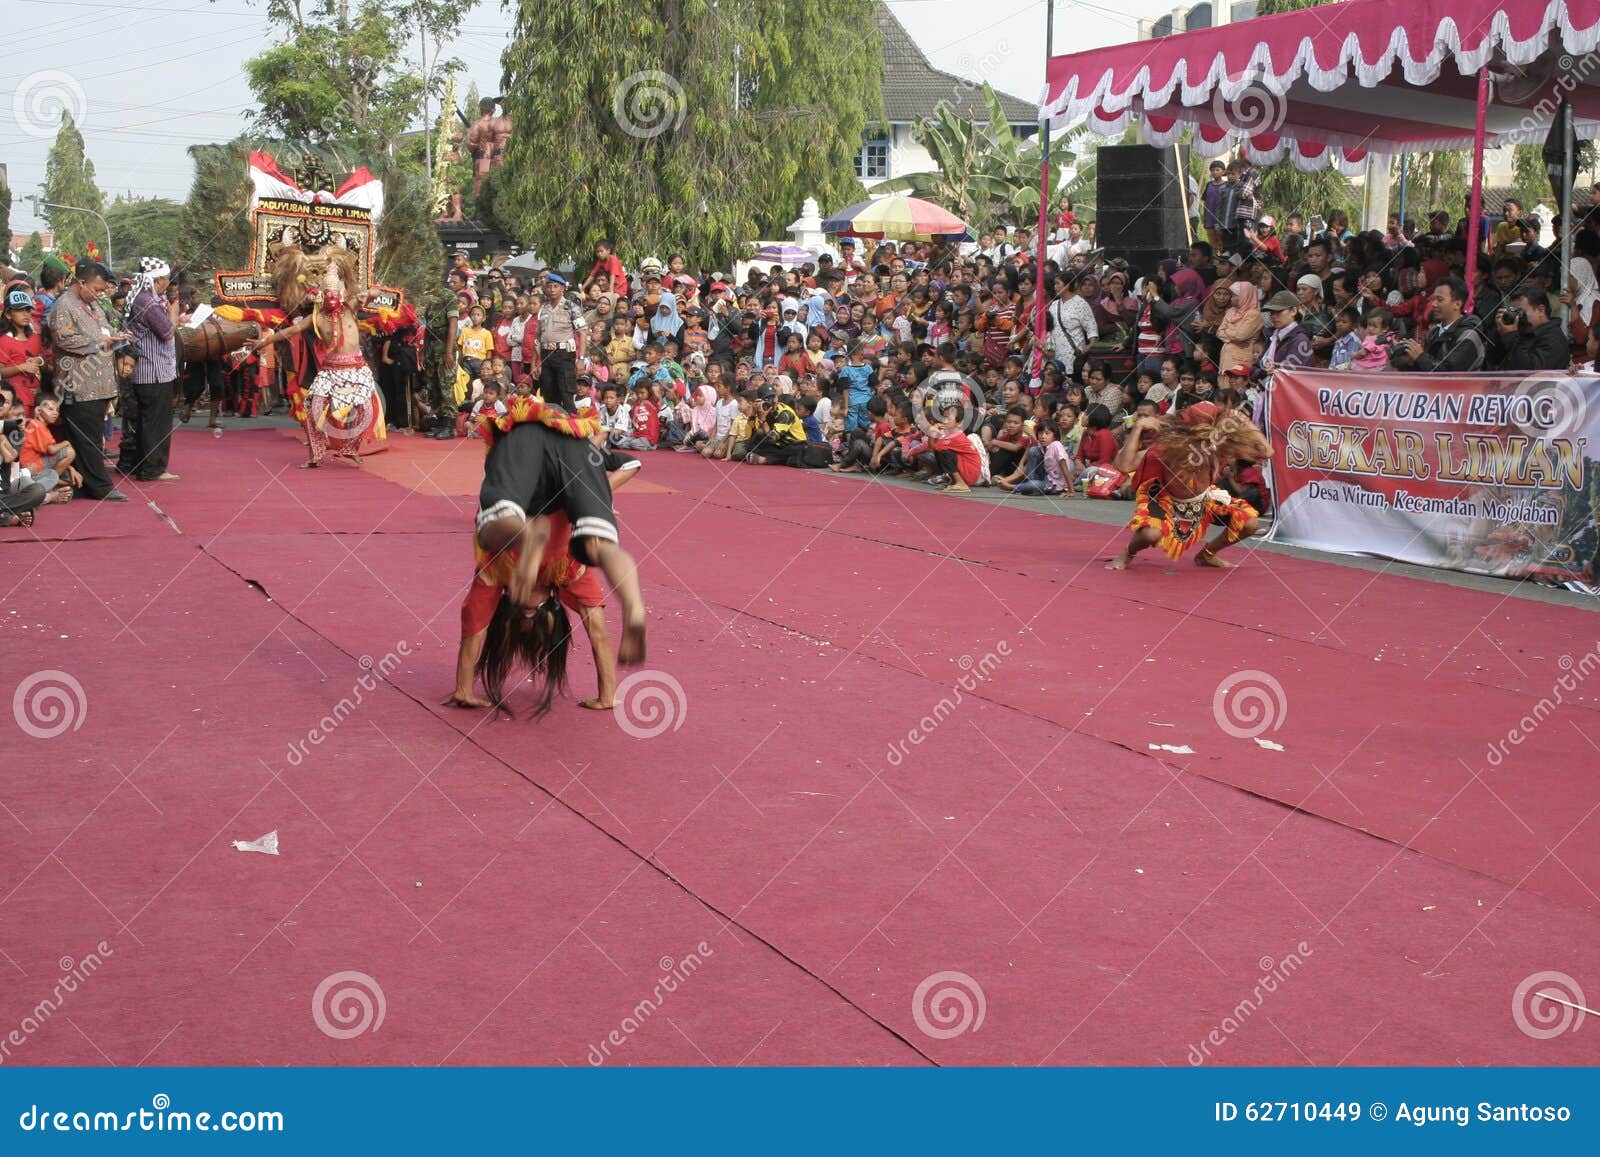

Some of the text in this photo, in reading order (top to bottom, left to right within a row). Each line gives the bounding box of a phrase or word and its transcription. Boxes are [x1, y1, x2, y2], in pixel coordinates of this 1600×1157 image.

[315, 207, 343, 217] SEKAR
[346, 209, 372, 220] LIMAN
[1318, 388, 1556, 426] PAGUYUBAN REYOG
[1286, 420, 1587, 492] SEKAR LIMAN
[1309, 481, 1558, 524] Desa Wirun, Kecamatan Mojolaban
